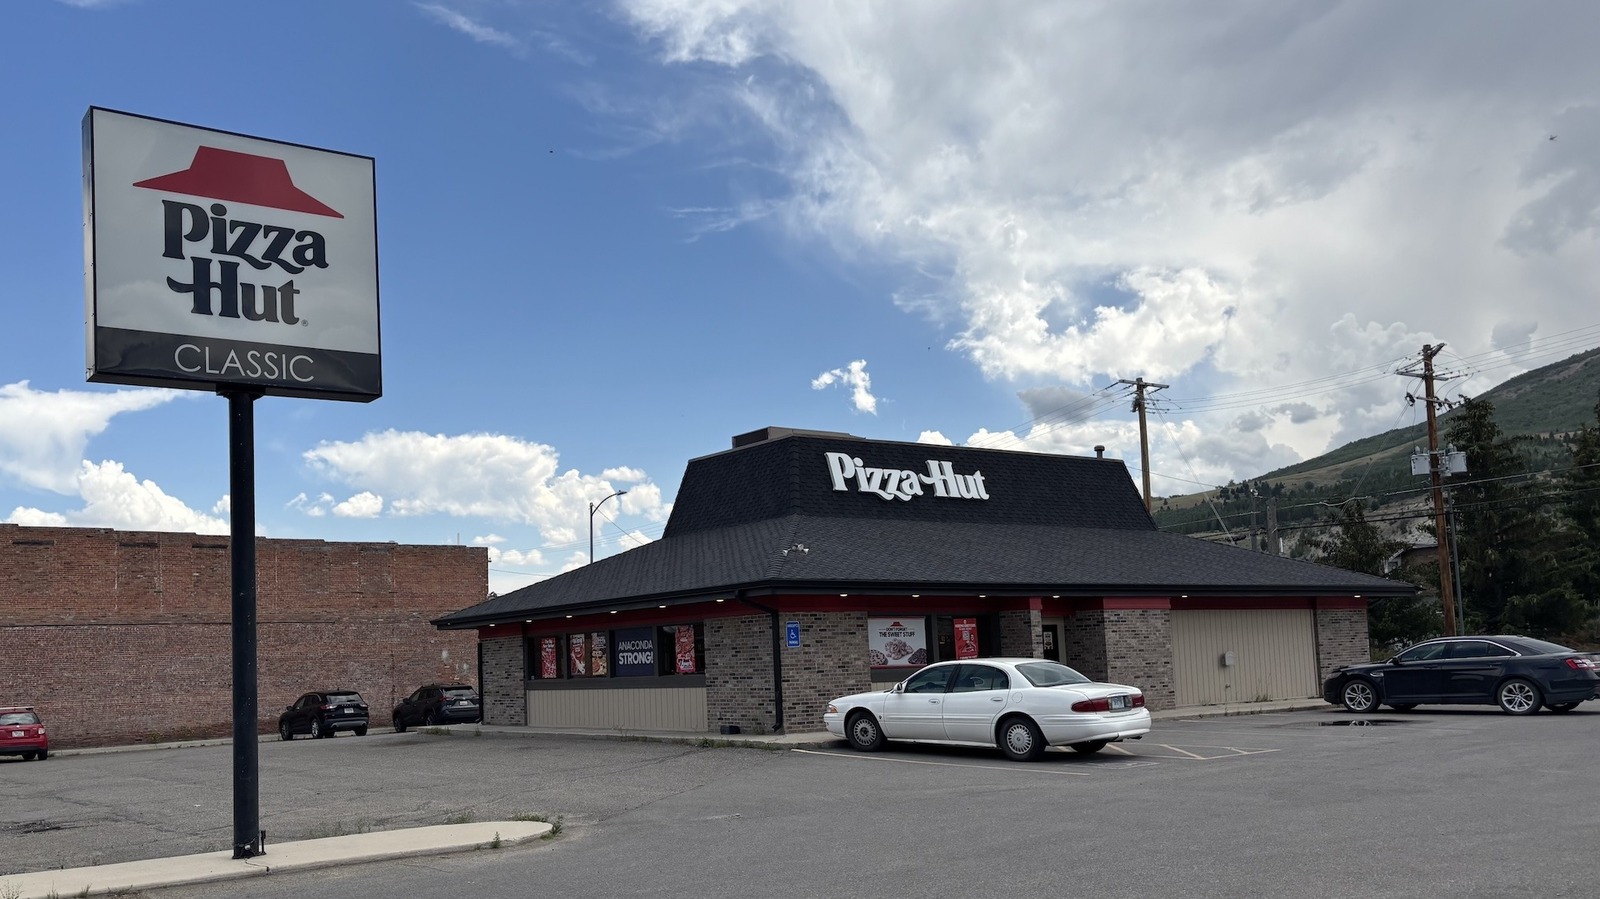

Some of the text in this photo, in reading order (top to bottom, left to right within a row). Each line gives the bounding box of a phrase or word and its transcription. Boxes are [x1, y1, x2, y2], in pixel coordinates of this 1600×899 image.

[162, 199, 329, 274] Pizza
[166, 256, 300, 325] Hut
[174, 343, 315, 382] CLASSIC
[824, 451, 990, 501] Pizza Hut
[618, 640, 653, 650] ANACONDA
[618, 651, 654, 665] STRONG!
